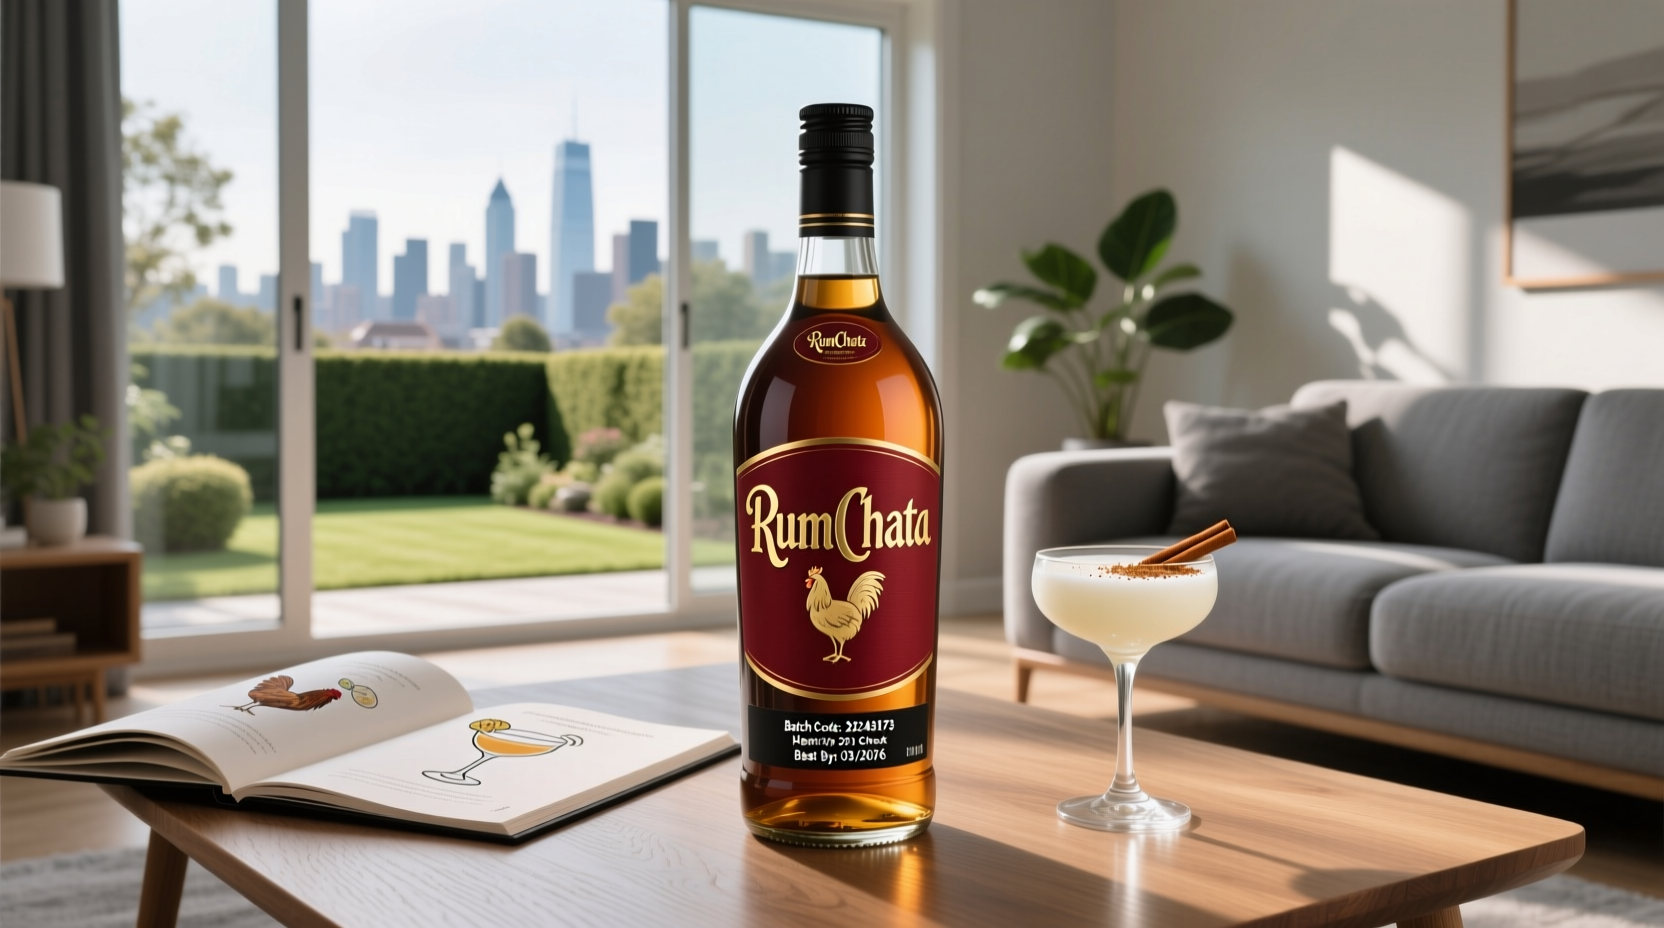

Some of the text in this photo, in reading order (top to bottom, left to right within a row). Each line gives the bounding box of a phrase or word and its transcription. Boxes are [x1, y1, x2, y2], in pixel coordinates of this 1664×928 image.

[746, 484, 931, 568] RumChata
[784, 720, 812, 733] Batch
[840, 748, 887, 762] 03/2076
